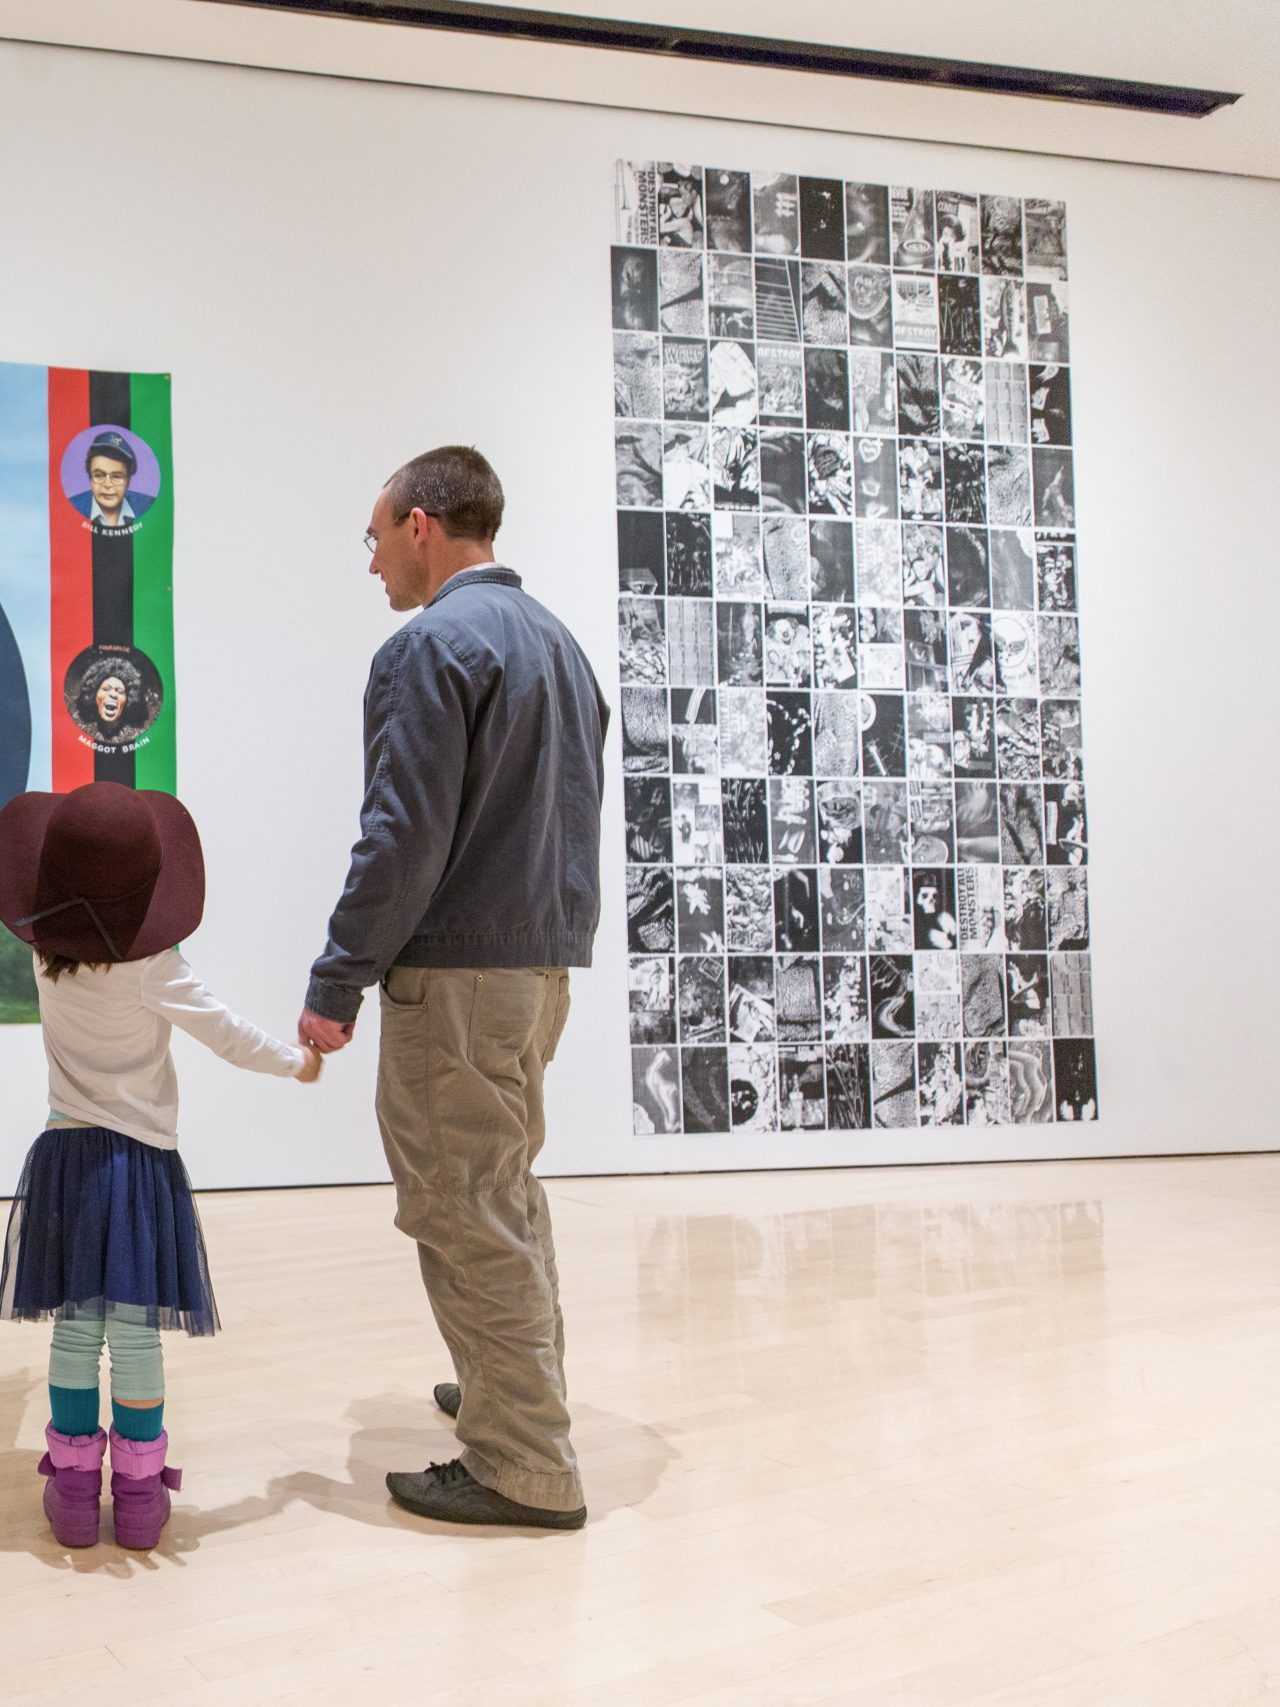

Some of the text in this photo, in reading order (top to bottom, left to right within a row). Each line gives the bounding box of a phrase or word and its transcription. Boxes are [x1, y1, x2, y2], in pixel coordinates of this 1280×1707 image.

[638, 170, 649, 245] MONSTERS
[102, 522, 143, 537] KENNEDY
[77, 734, 151, 754] MAGGOT BRAIN
[958, 887, 969, 941] DESTROY
[965, 867, 978, 940] MONSTERS
